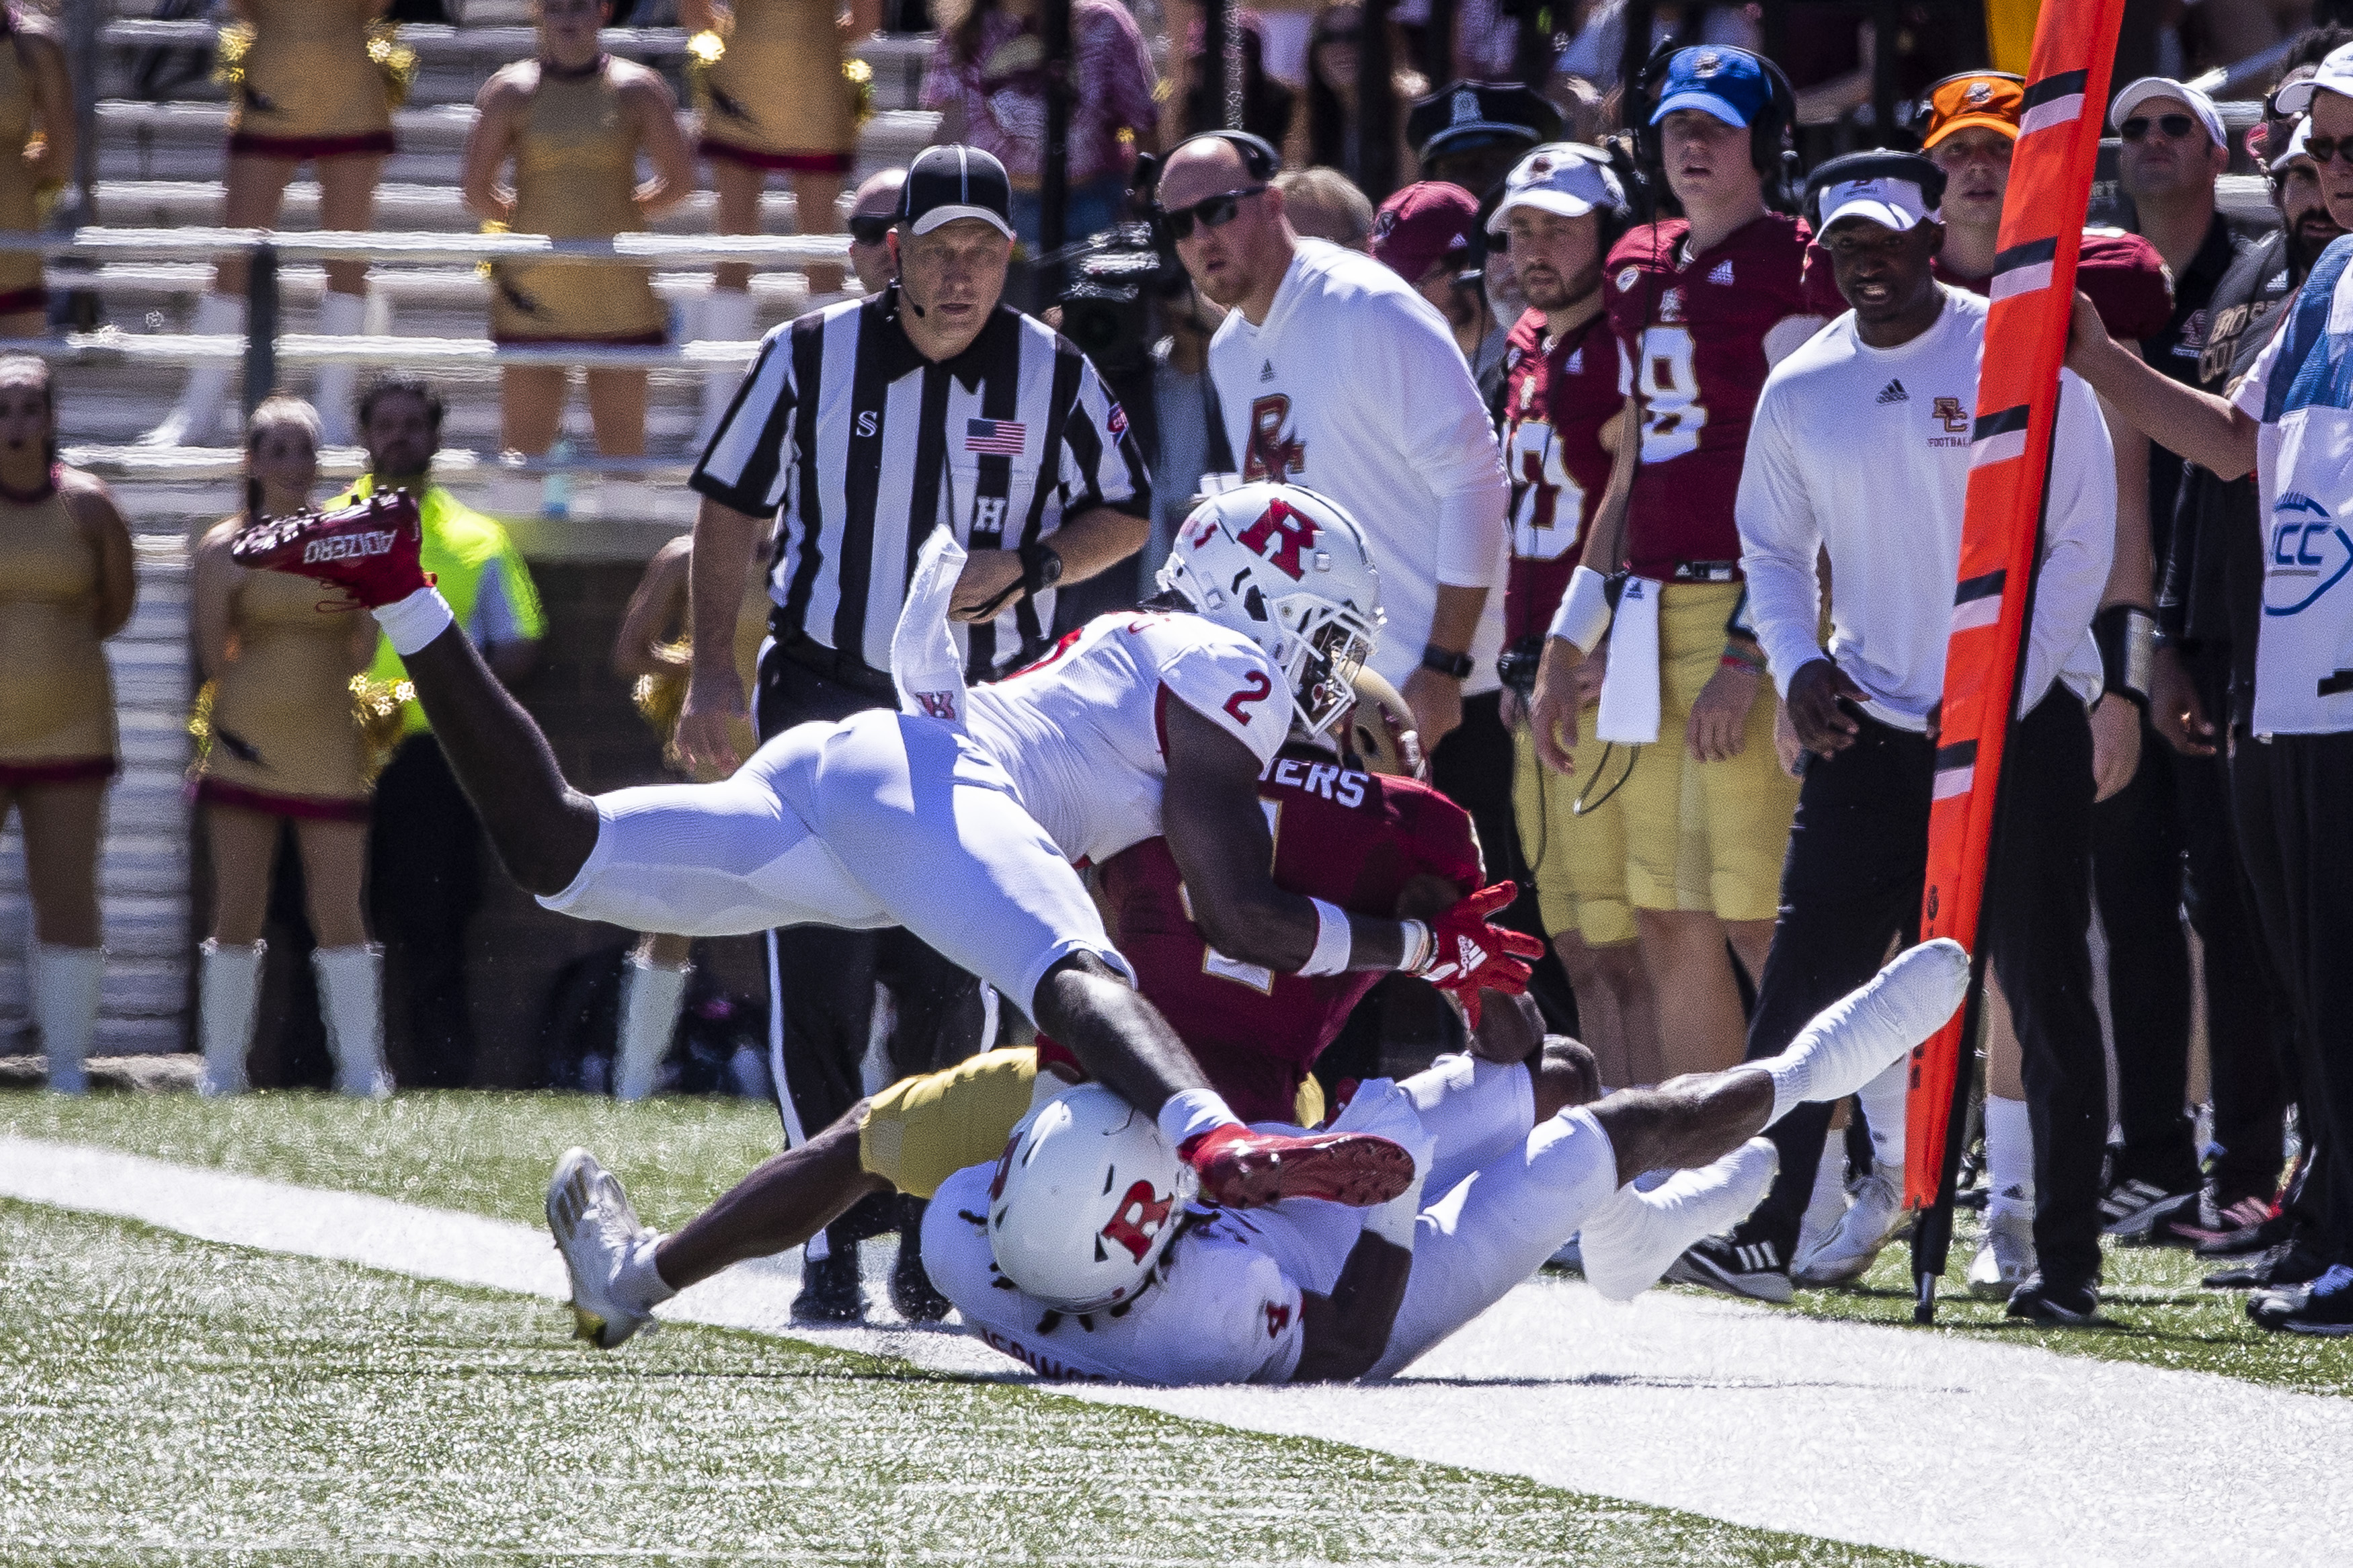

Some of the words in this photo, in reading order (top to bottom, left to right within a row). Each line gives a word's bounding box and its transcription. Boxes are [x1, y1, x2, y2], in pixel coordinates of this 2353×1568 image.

[1636, 324, 1709, 464] 8
[856, 410, 877, 438] S
[973, 495, 1006, 533] H
[1236, 497, 1323, 583] R
[2270, 522, 2332, 566] CC
[1222, 669, 1272, 727] 2
[1101, 1179, 1174, 1266] R
[1265, 1300, 1293, 1339] 4
